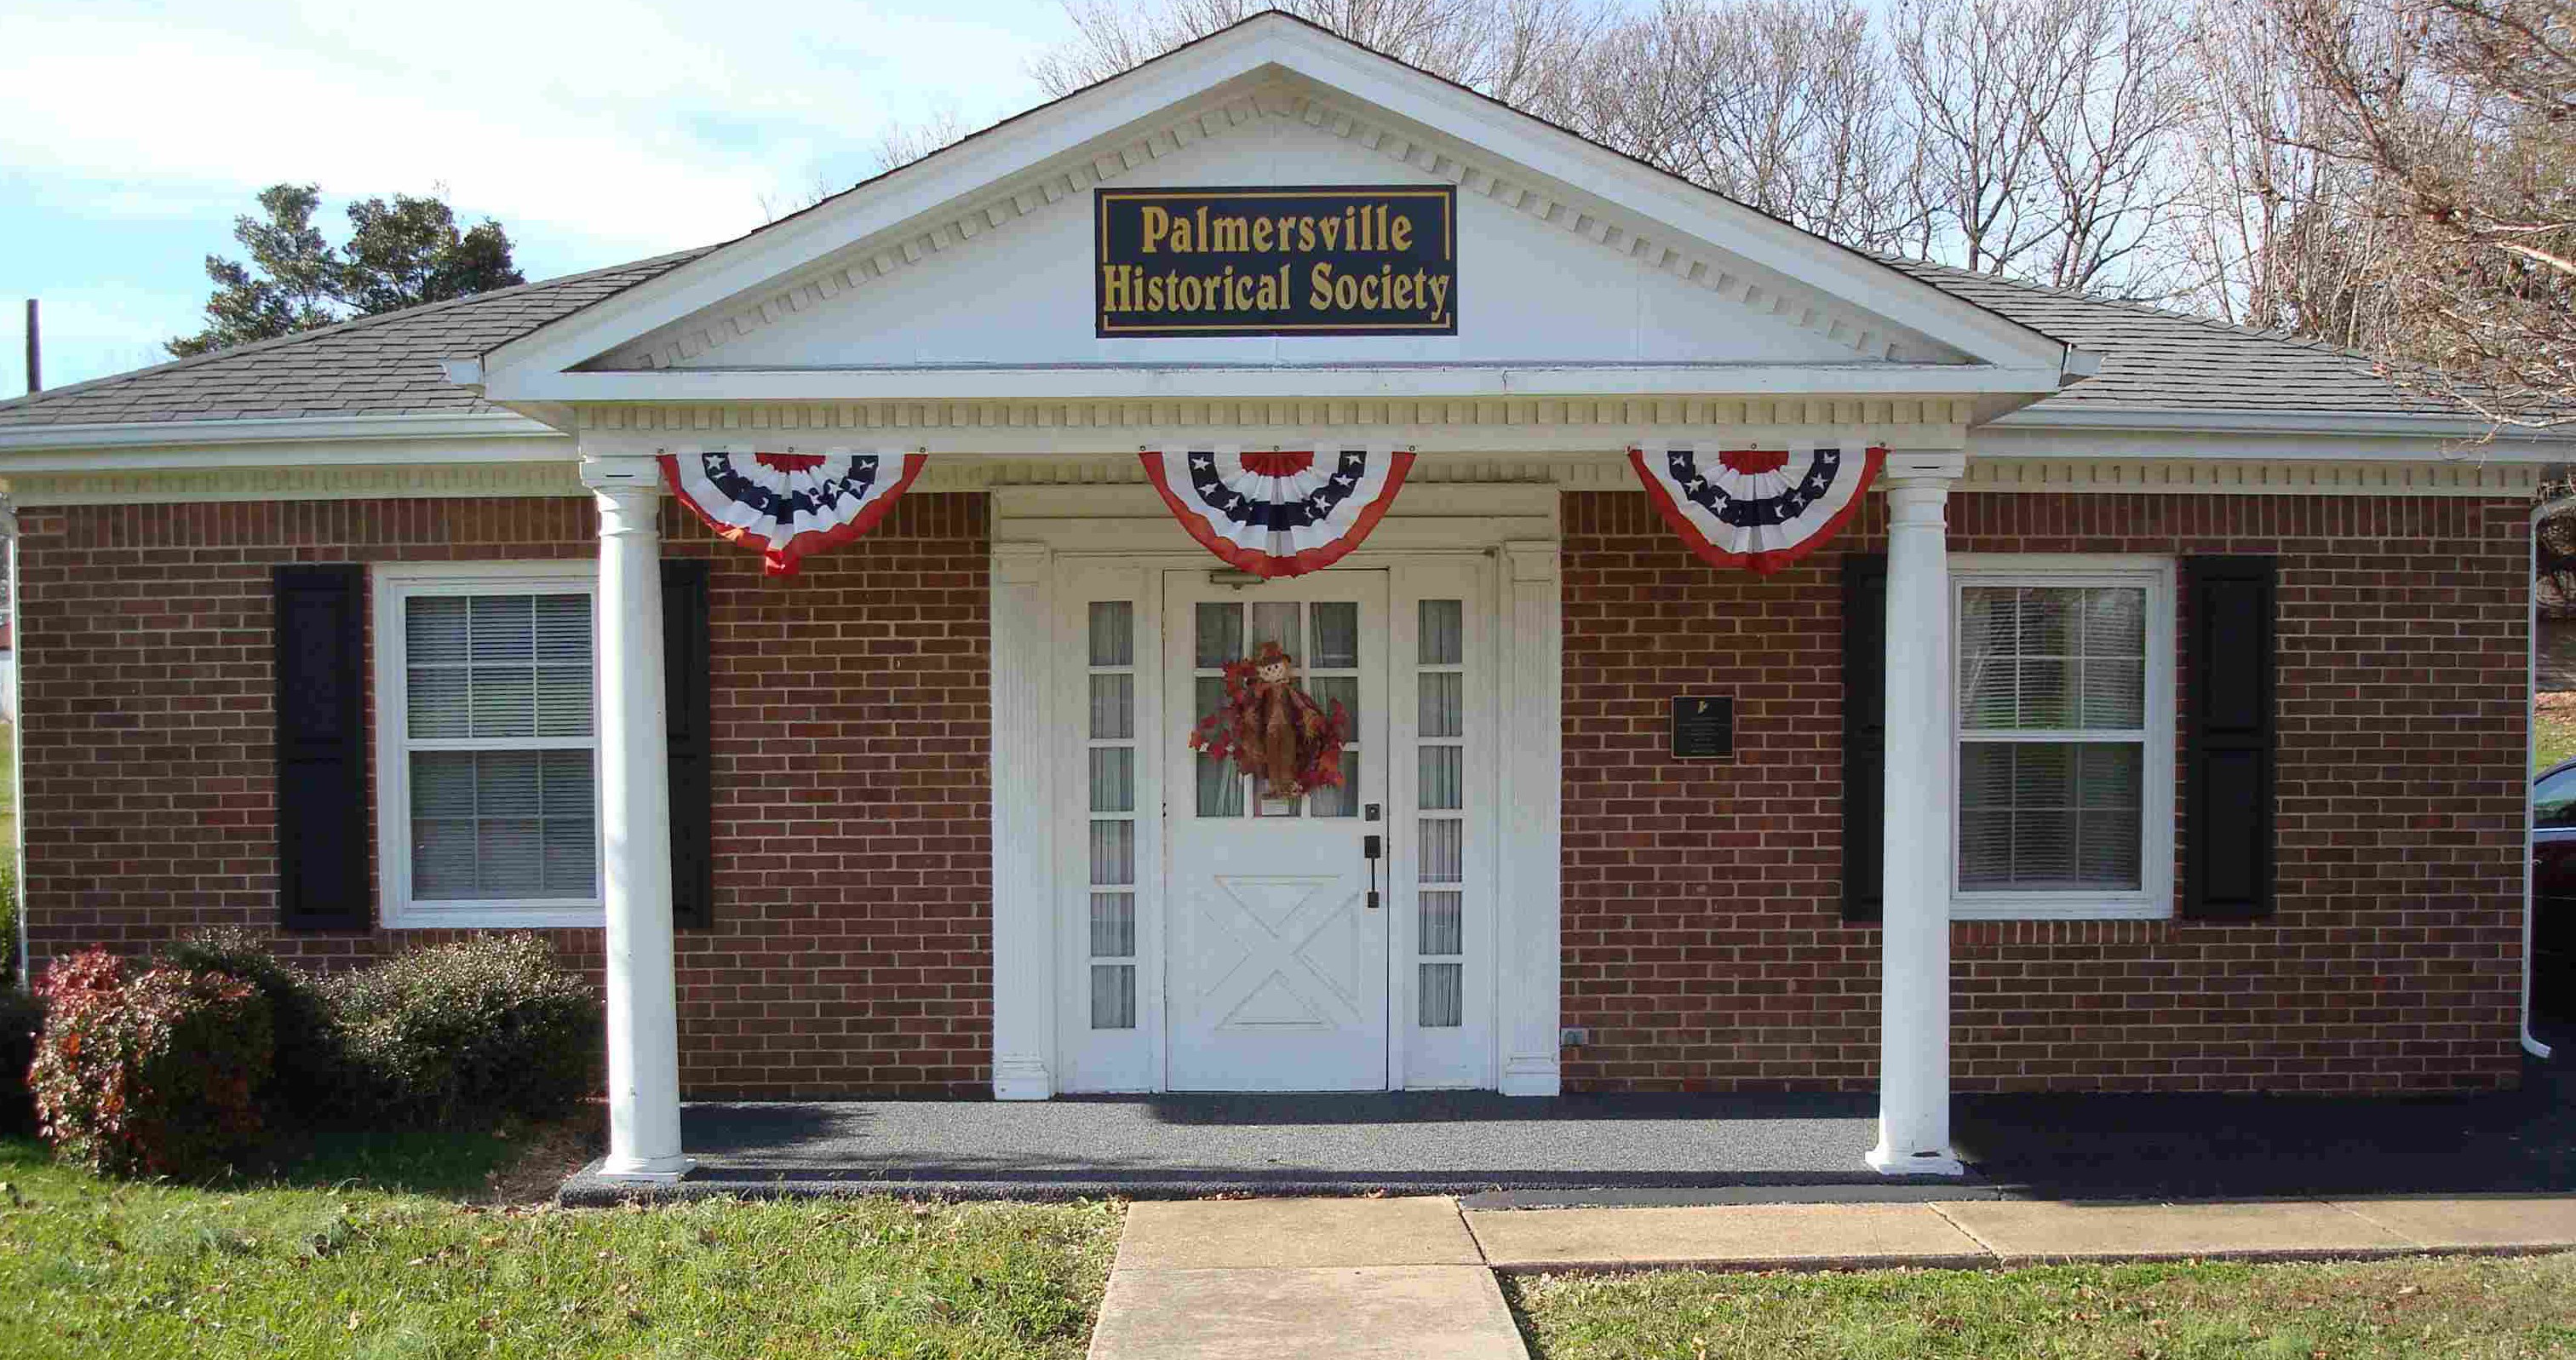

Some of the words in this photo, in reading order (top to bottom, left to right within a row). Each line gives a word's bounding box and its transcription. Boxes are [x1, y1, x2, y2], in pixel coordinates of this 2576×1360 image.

[1140, 204, 1413, 254] Palmersville
[1104, 263, 1292, 312] Historical
[1309, 261, 1450, 321] Society
